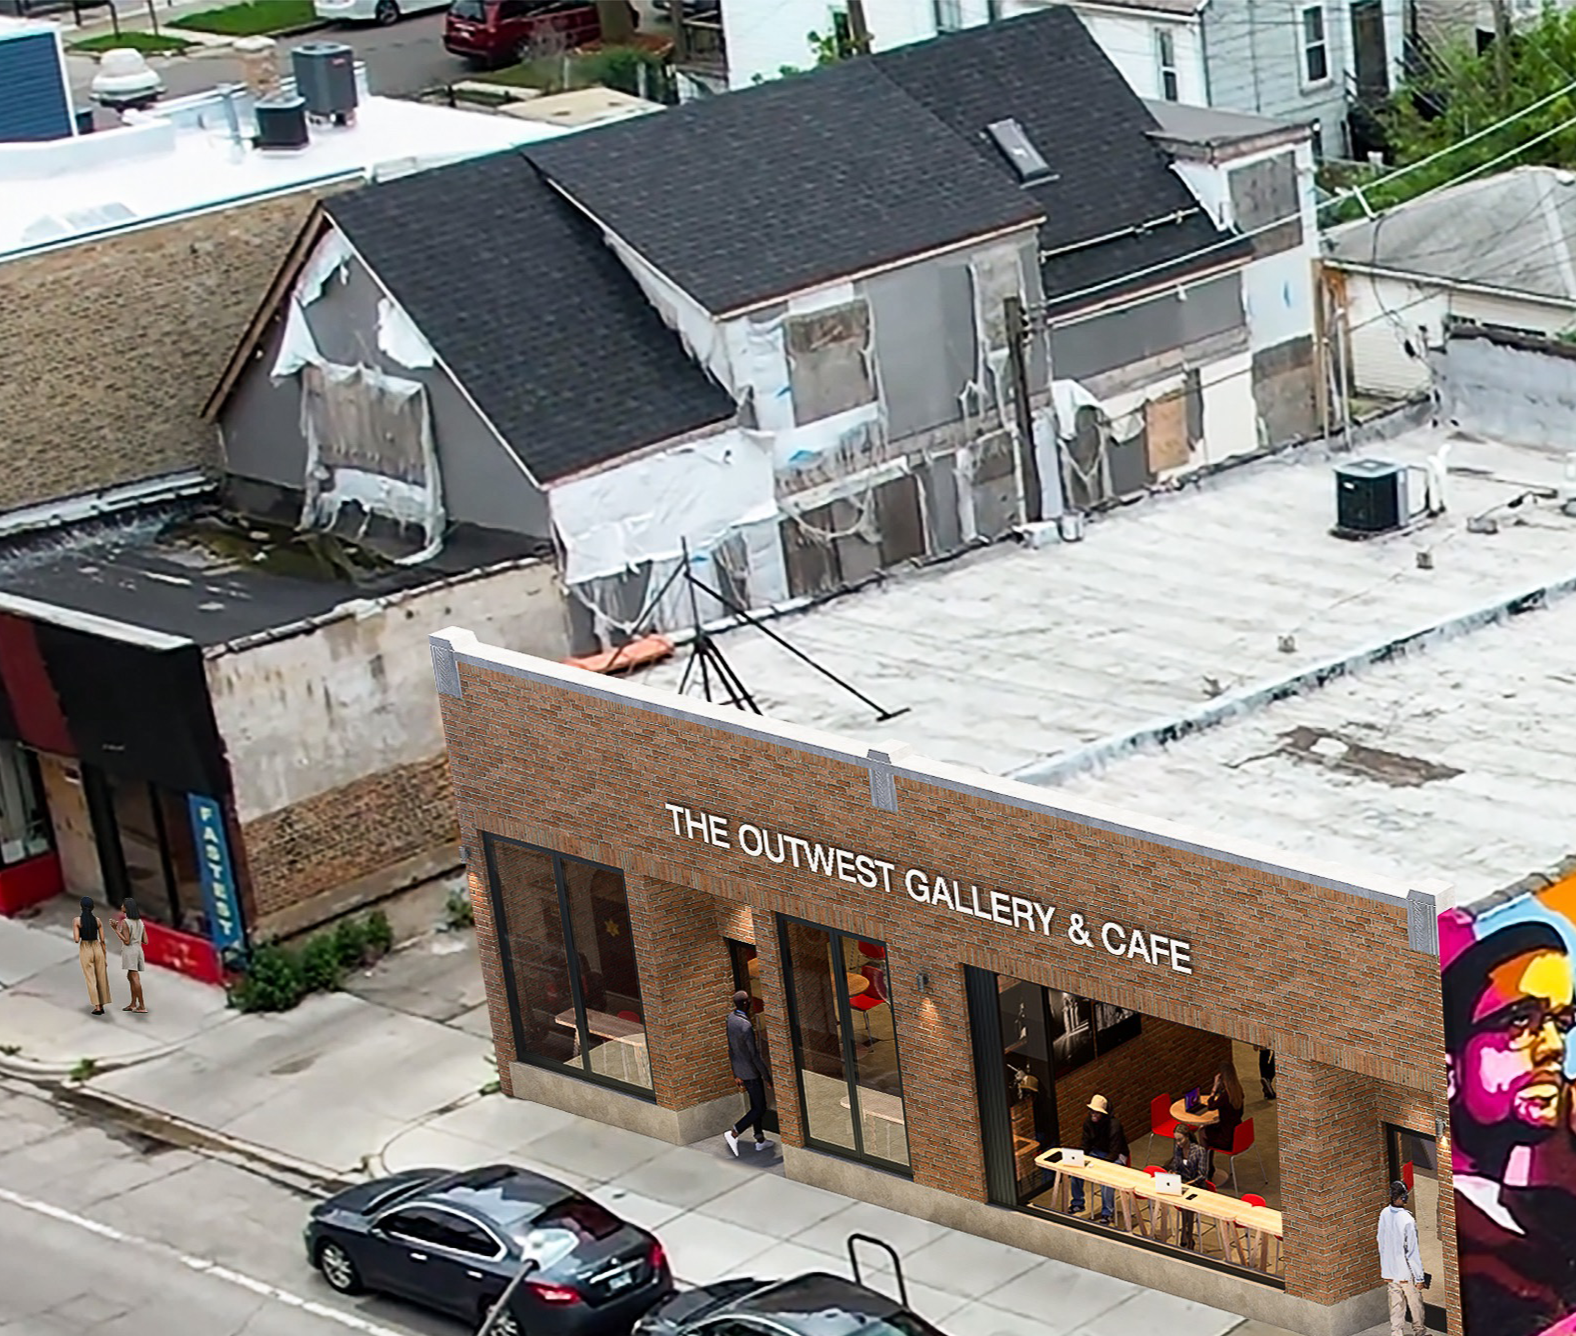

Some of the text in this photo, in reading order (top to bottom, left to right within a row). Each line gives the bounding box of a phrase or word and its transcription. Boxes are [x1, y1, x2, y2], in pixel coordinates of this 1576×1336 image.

[199, 806, 233, 936] FASTEST
[664, 803, 1193, 975] THE OUTWEST GALLERY & CAFE
